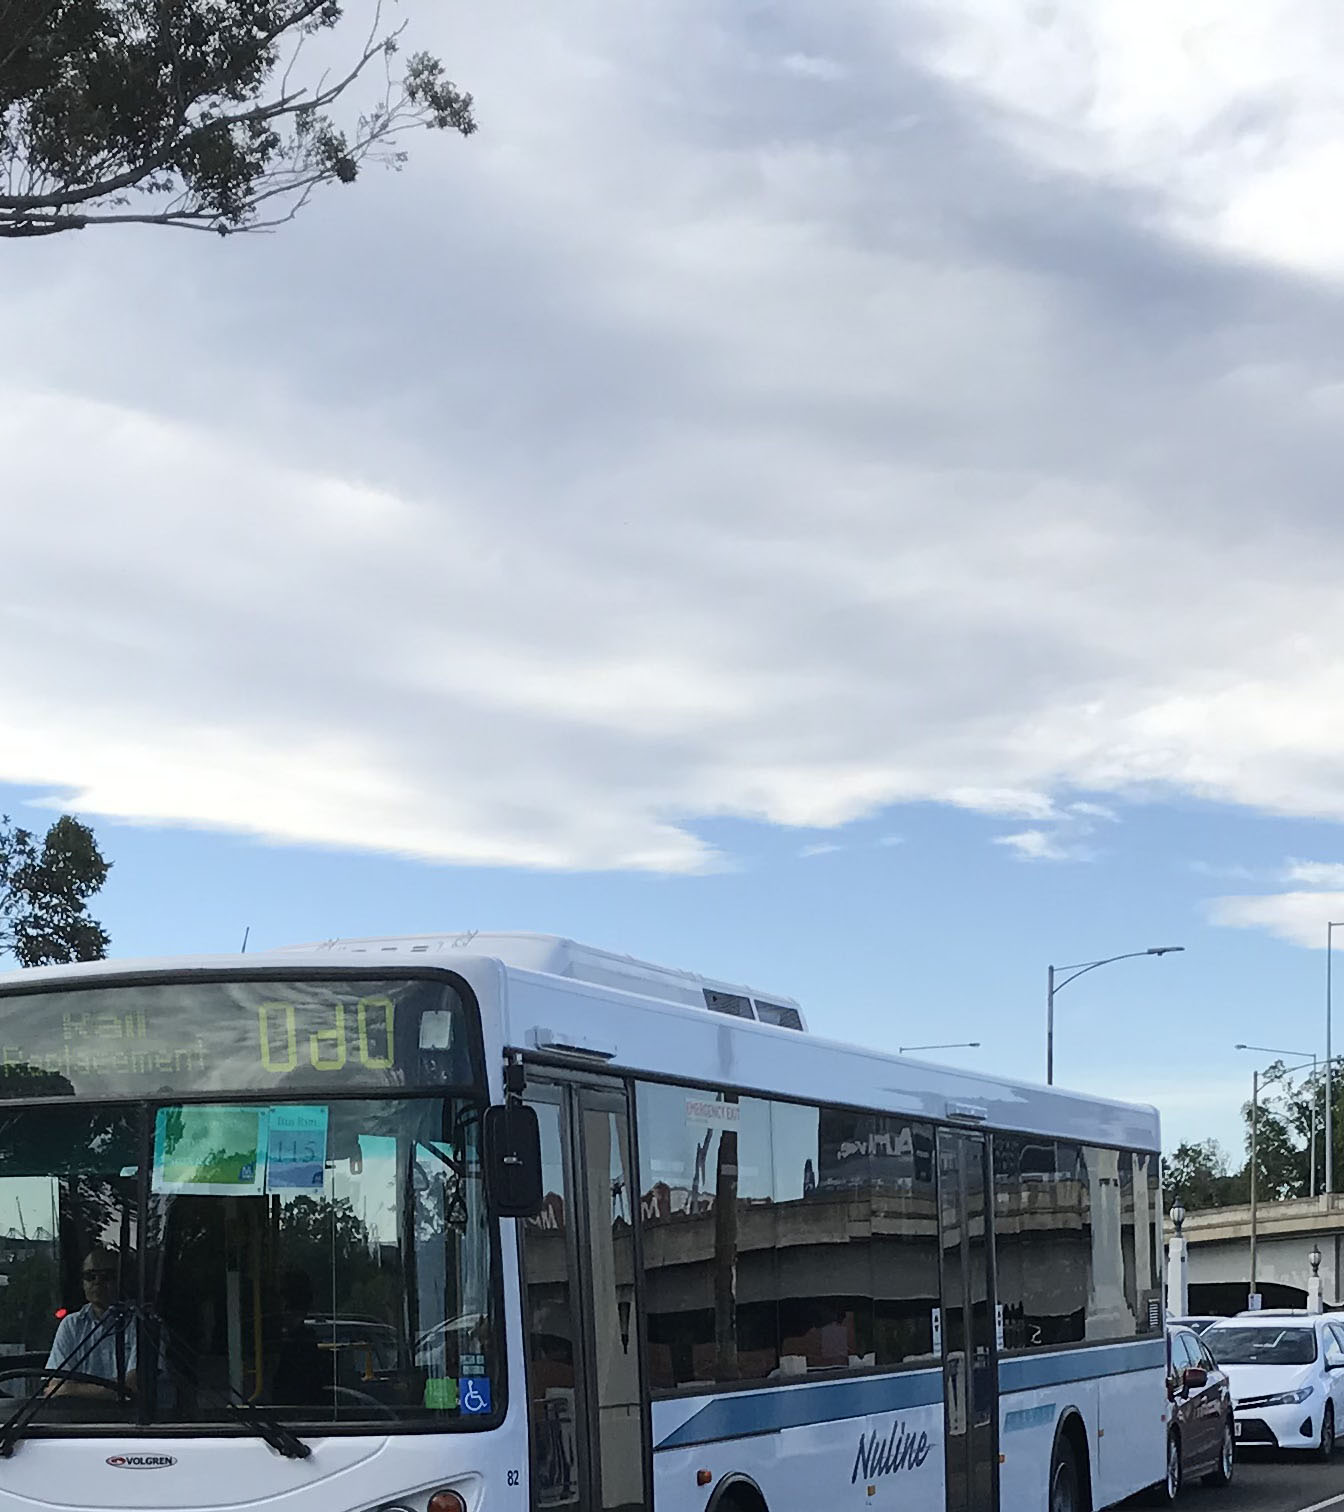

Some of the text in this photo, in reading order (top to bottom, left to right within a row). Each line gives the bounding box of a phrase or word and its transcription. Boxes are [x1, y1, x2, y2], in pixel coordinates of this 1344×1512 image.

[851, 1419, 933, 1484] Nuline
[126, 1456, 173, 1466] VOLGREN
[507, 1470, 519, 1486] 82
